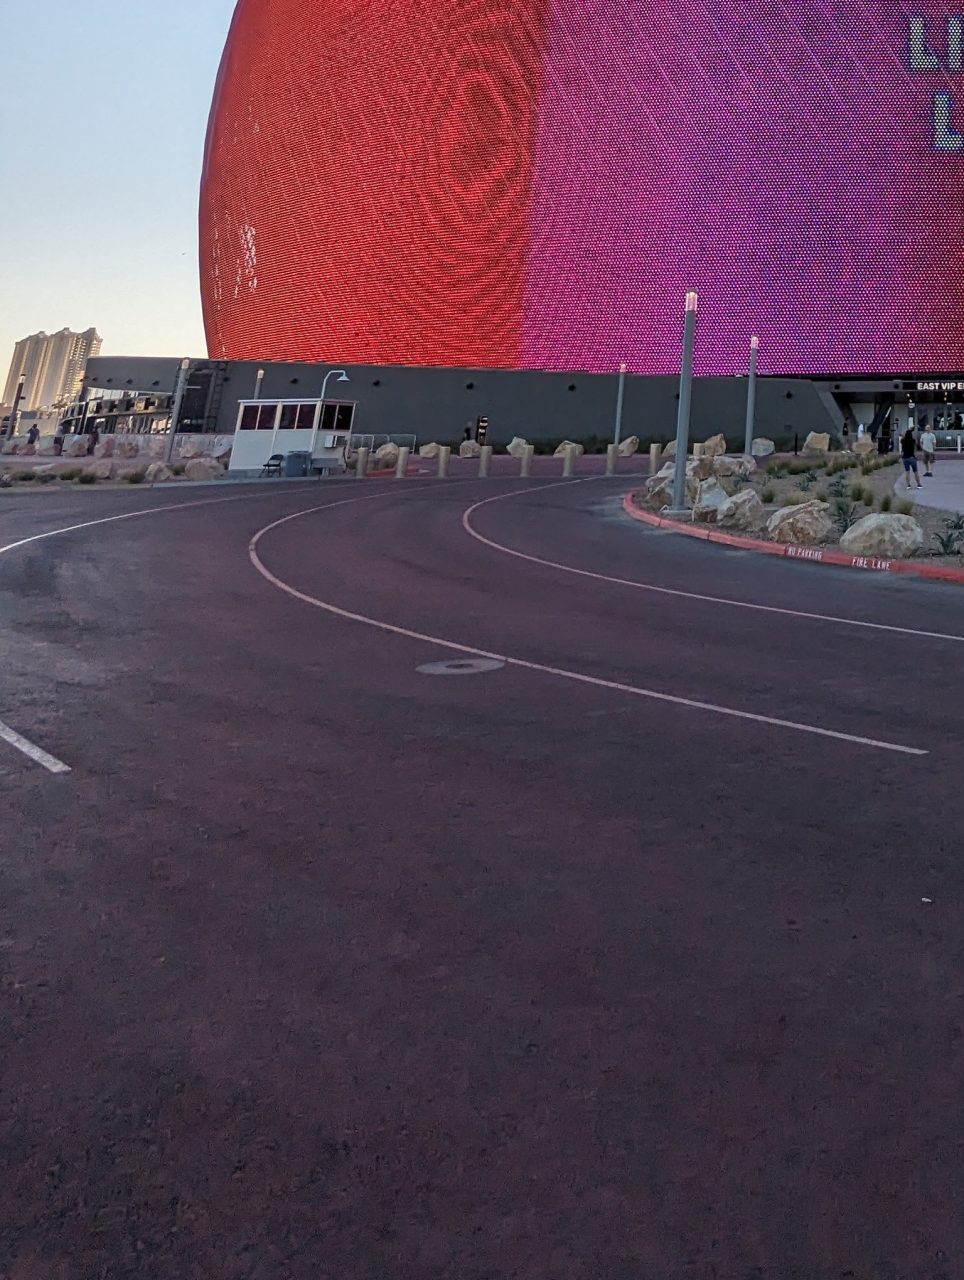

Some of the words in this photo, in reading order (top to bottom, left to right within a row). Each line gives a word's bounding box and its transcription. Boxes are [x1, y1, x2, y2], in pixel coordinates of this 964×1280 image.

[917, 382, 939, 390] EAST
[941, 382, 956, 390] VIP
[797, 547, 822, 560] PARKING
[852, 556, 868, 569] FIRE
[871, 559, 891, 571] LANE
